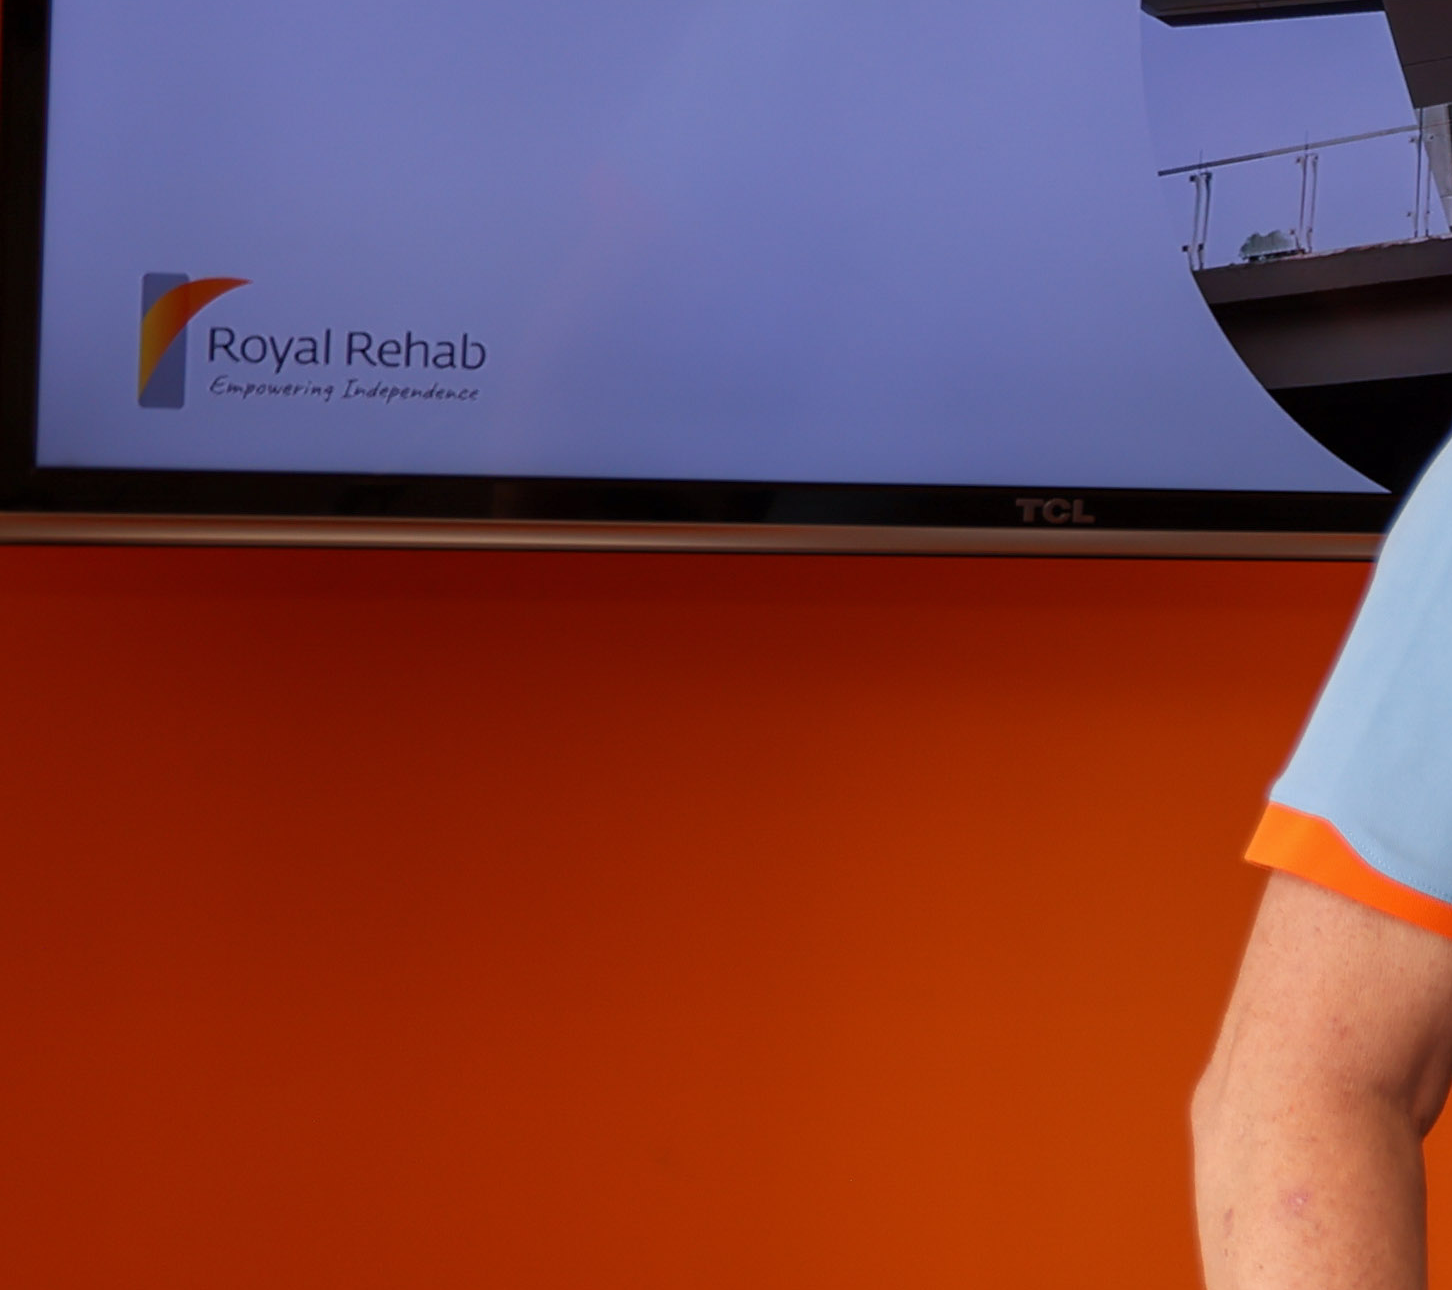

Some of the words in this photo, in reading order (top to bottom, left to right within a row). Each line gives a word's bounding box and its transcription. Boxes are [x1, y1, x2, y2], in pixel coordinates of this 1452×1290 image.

[207, 326, 331, 375] Royal
[345, 330, 487, 371] Rehab
[209, 375, 335, 403] Empowering
[341, 377, 480, 404] Independence
[1015, 497, 1097, 525] TCL
